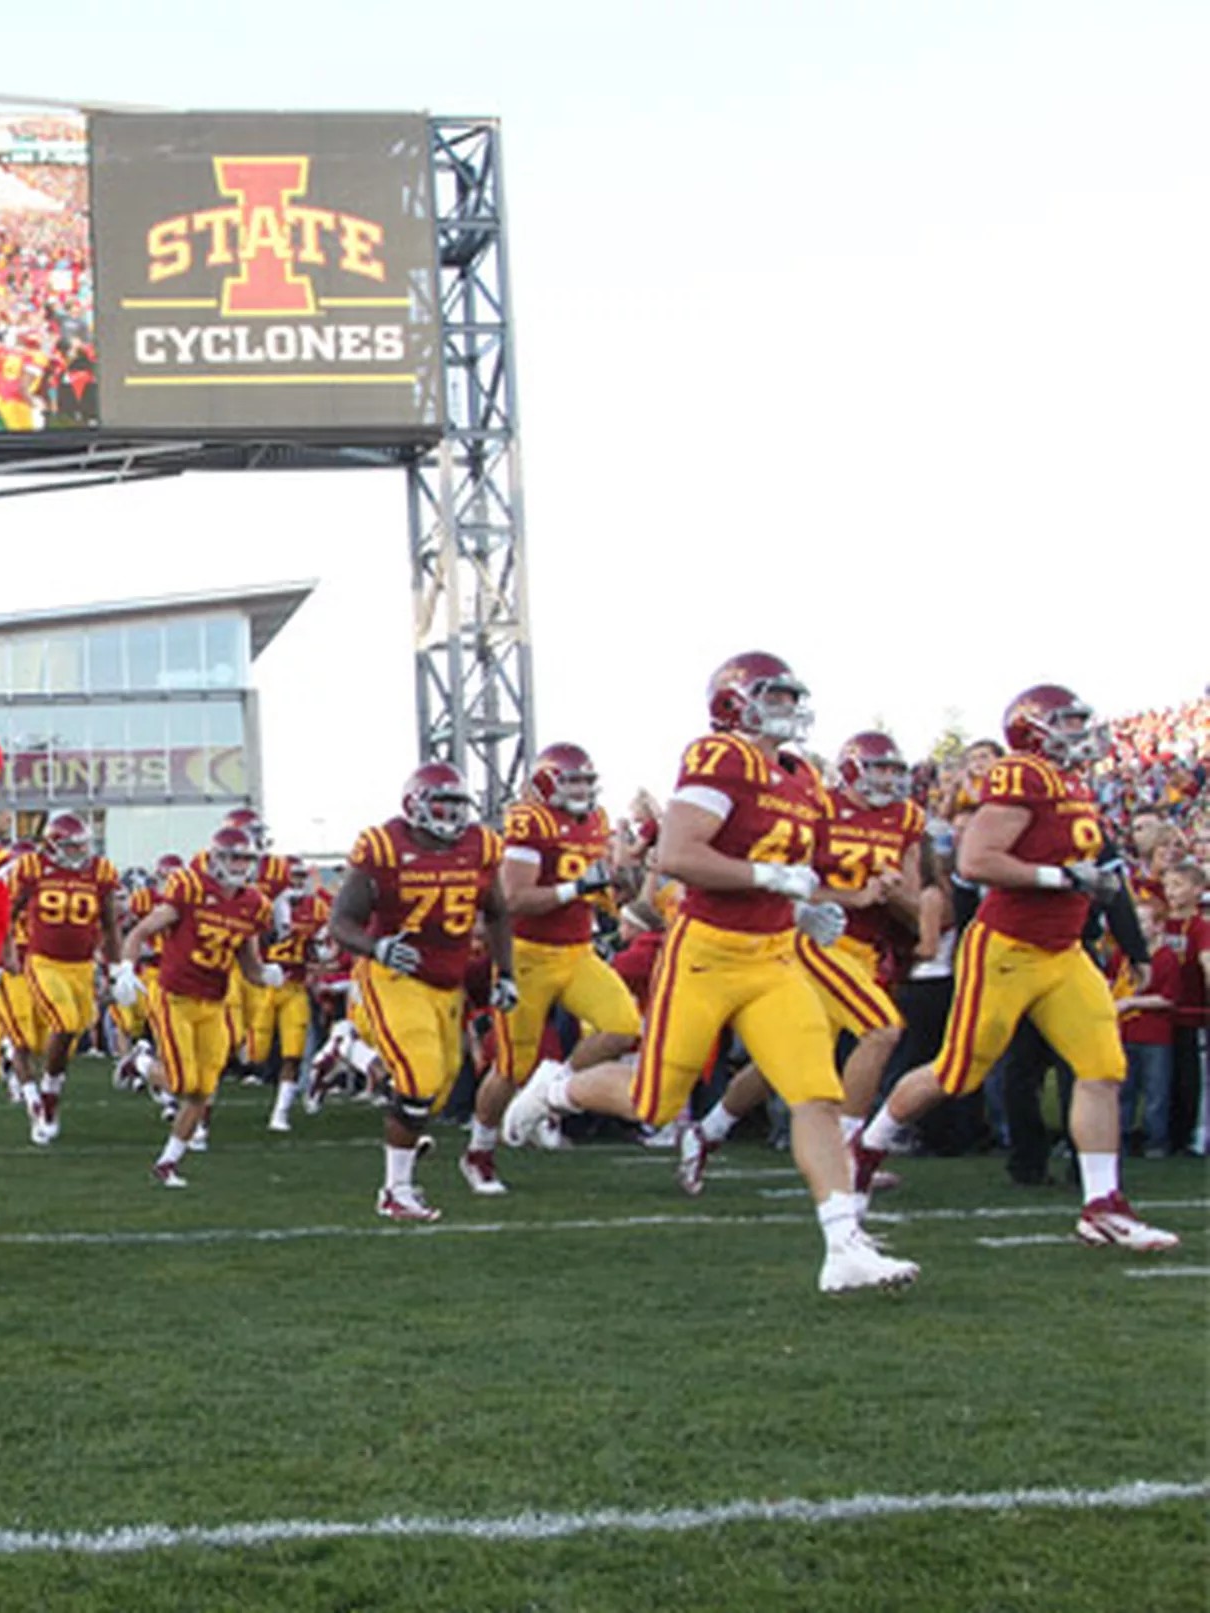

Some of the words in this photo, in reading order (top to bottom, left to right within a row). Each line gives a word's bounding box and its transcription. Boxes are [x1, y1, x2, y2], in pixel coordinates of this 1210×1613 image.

[146, 206, 386, 283] STATE
[134, 325, 405, 364] CYCLONES
[3, 755, 167, 790] LONES
[684, 741, 728, 775] 47
[990, 765, 1025, 796] 91
[38, 889, 99, 926] 90
[399, 886, 479, 935] 75
